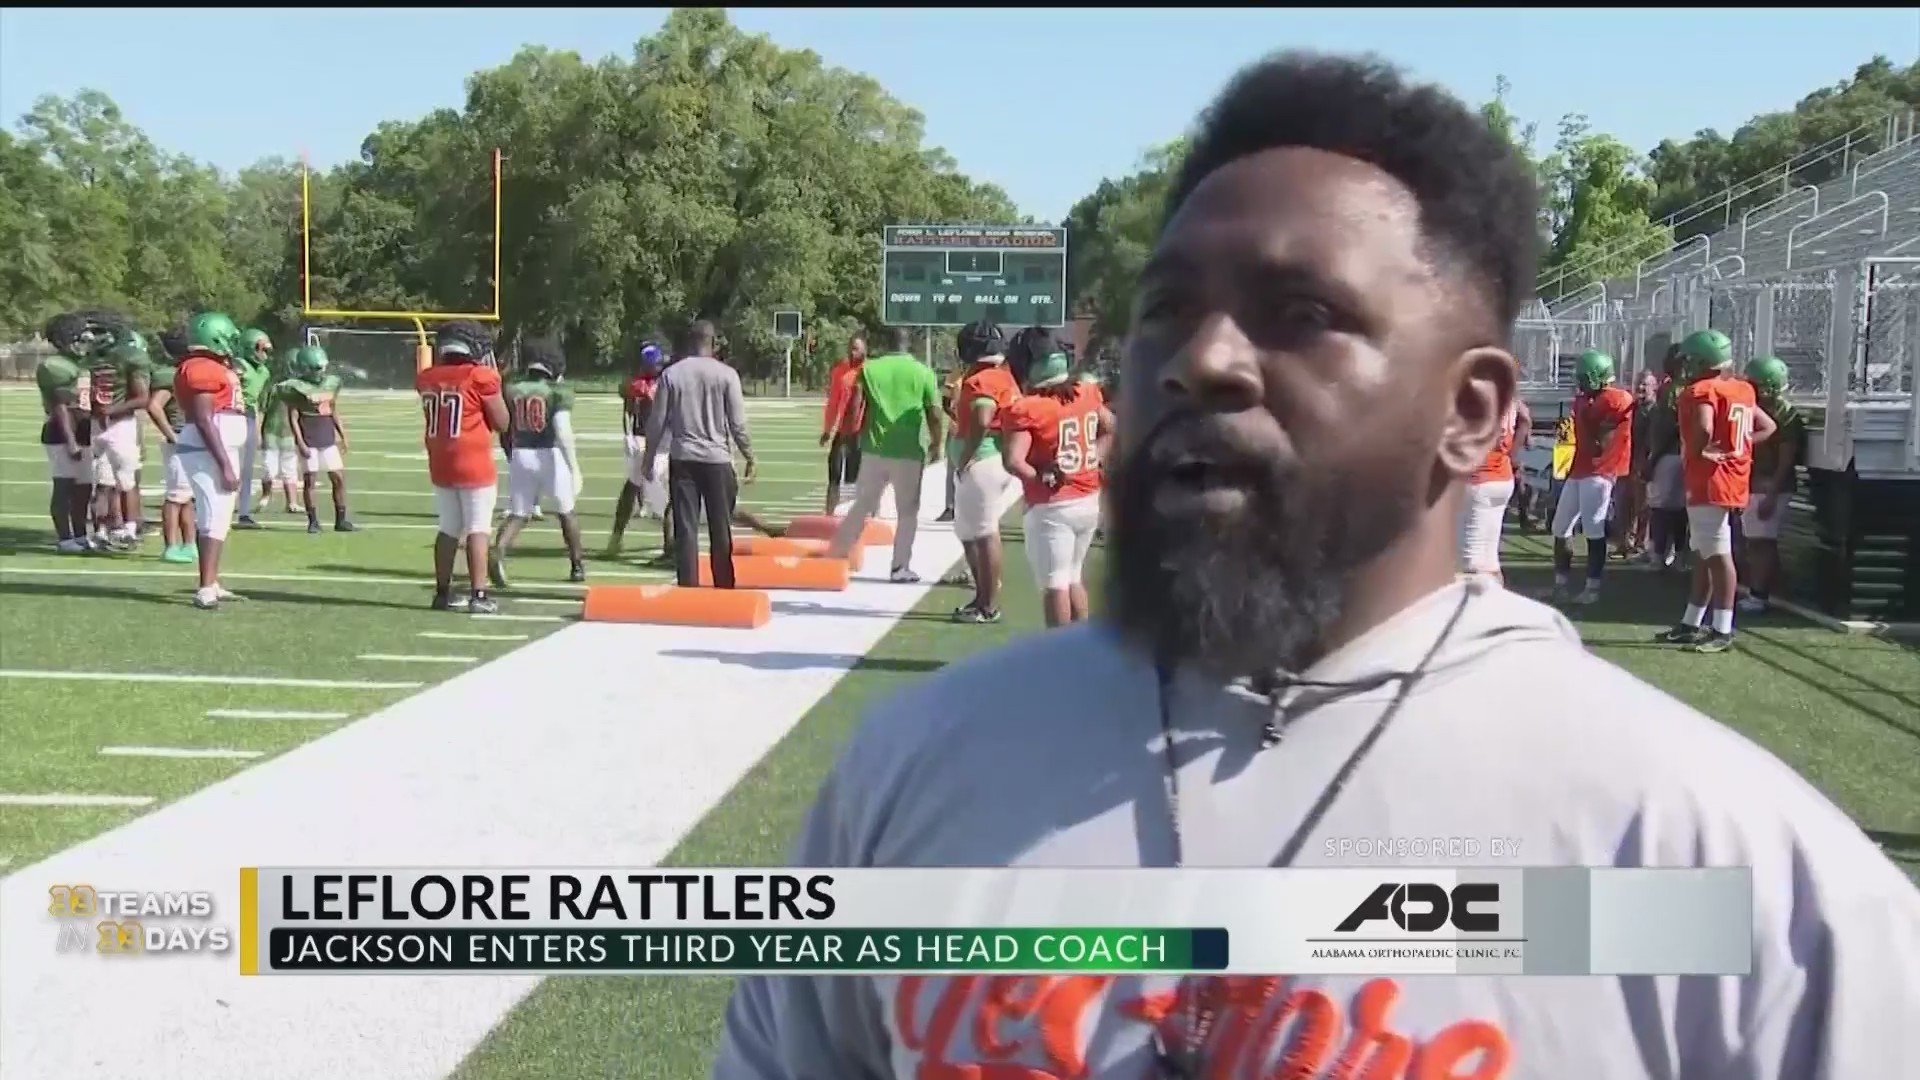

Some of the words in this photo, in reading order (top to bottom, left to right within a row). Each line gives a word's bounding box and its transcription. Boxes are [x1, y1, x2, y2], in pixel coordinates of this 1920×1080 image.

[890, 293, 921, 303] DOWN
[932, 293, 946, 303] TO
[948, 294, 963, 303] GO
[974, 295, 1001, 304] BALL
[1004, 295, 1019, 304] ON
[421, 391, 463, 438] 77
